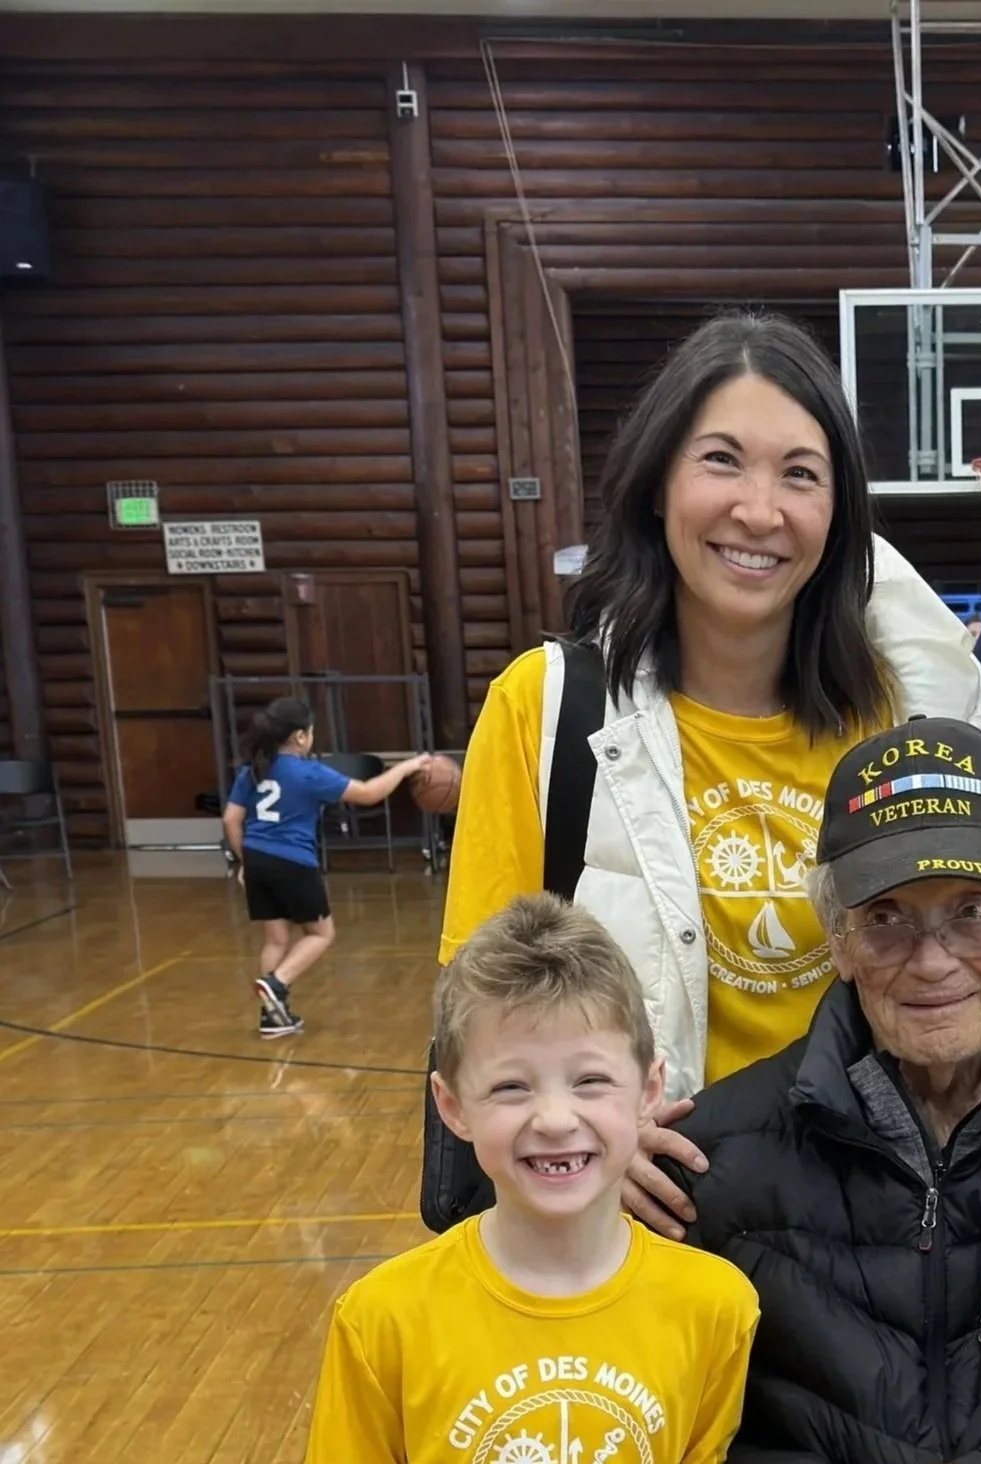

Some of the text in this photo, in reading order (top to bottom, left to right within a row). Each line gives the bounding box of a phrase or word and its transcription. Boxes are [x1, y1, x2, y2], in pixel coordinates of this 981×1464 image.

[168, 523, 256, 535] WOMENS RESTROOM
[235, 535, 258, 545] ROOM
[858, 739, 976, 786] KOREA
[256, 779, 281, 822] 2
[703, 782, 730, 809] OF
[736, 778, 773, 801] DES
[870, 799, 971, 826] VETERAN
[449, 1356, 665, 1450] CITY OF DES MOINES
